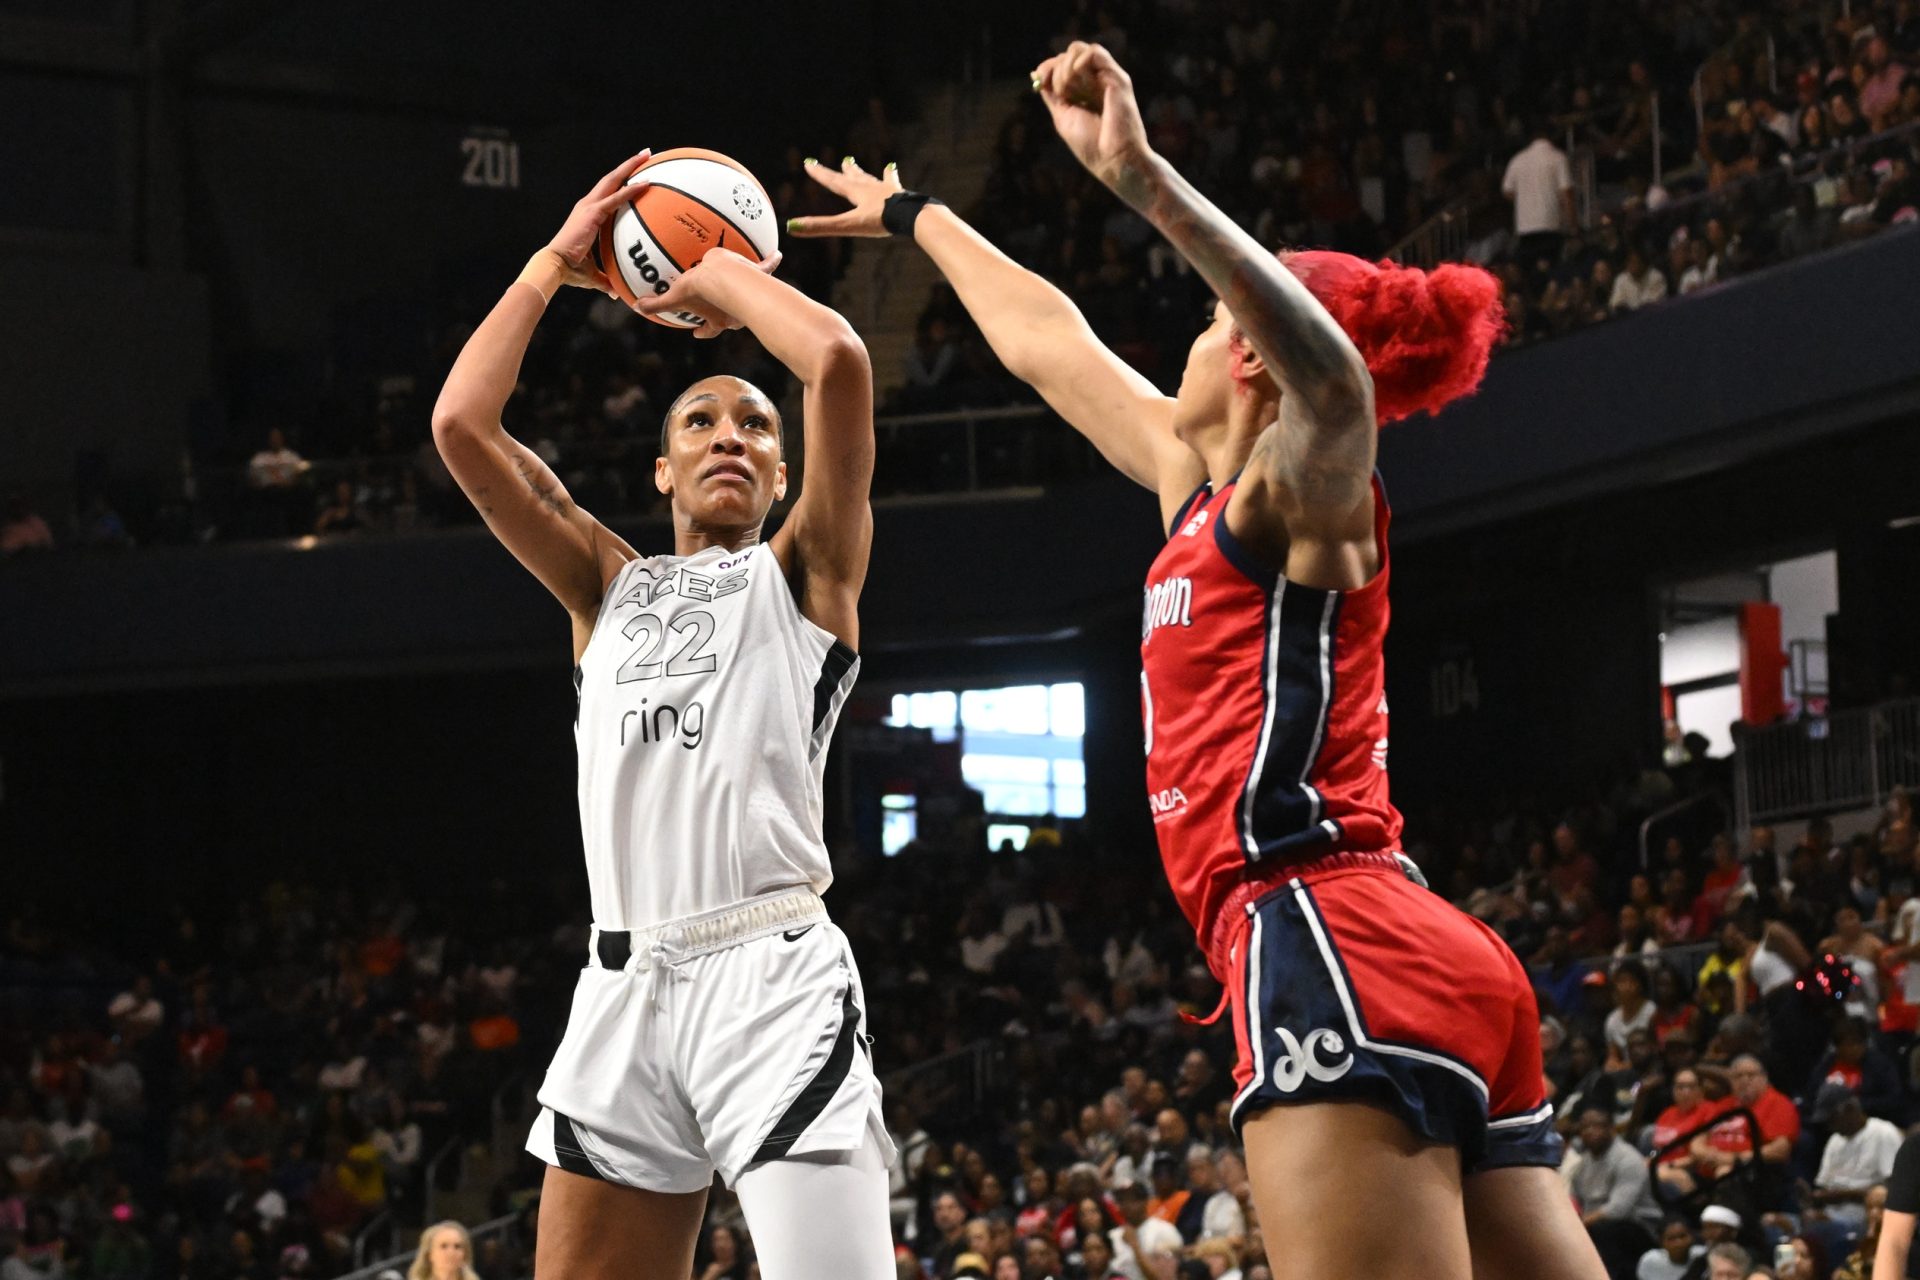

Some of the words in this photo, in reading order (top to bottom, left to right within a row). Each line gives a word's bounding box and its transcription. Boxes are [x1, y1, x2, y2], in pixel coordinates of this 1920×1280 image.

[460, 137, 520, 188] 201
[615, 568, 748, 609] ACES
[616, 610, 717, 685] 22
[620, 697, 704, 750] ring
[1149, 787, 1188, 815] NDA
